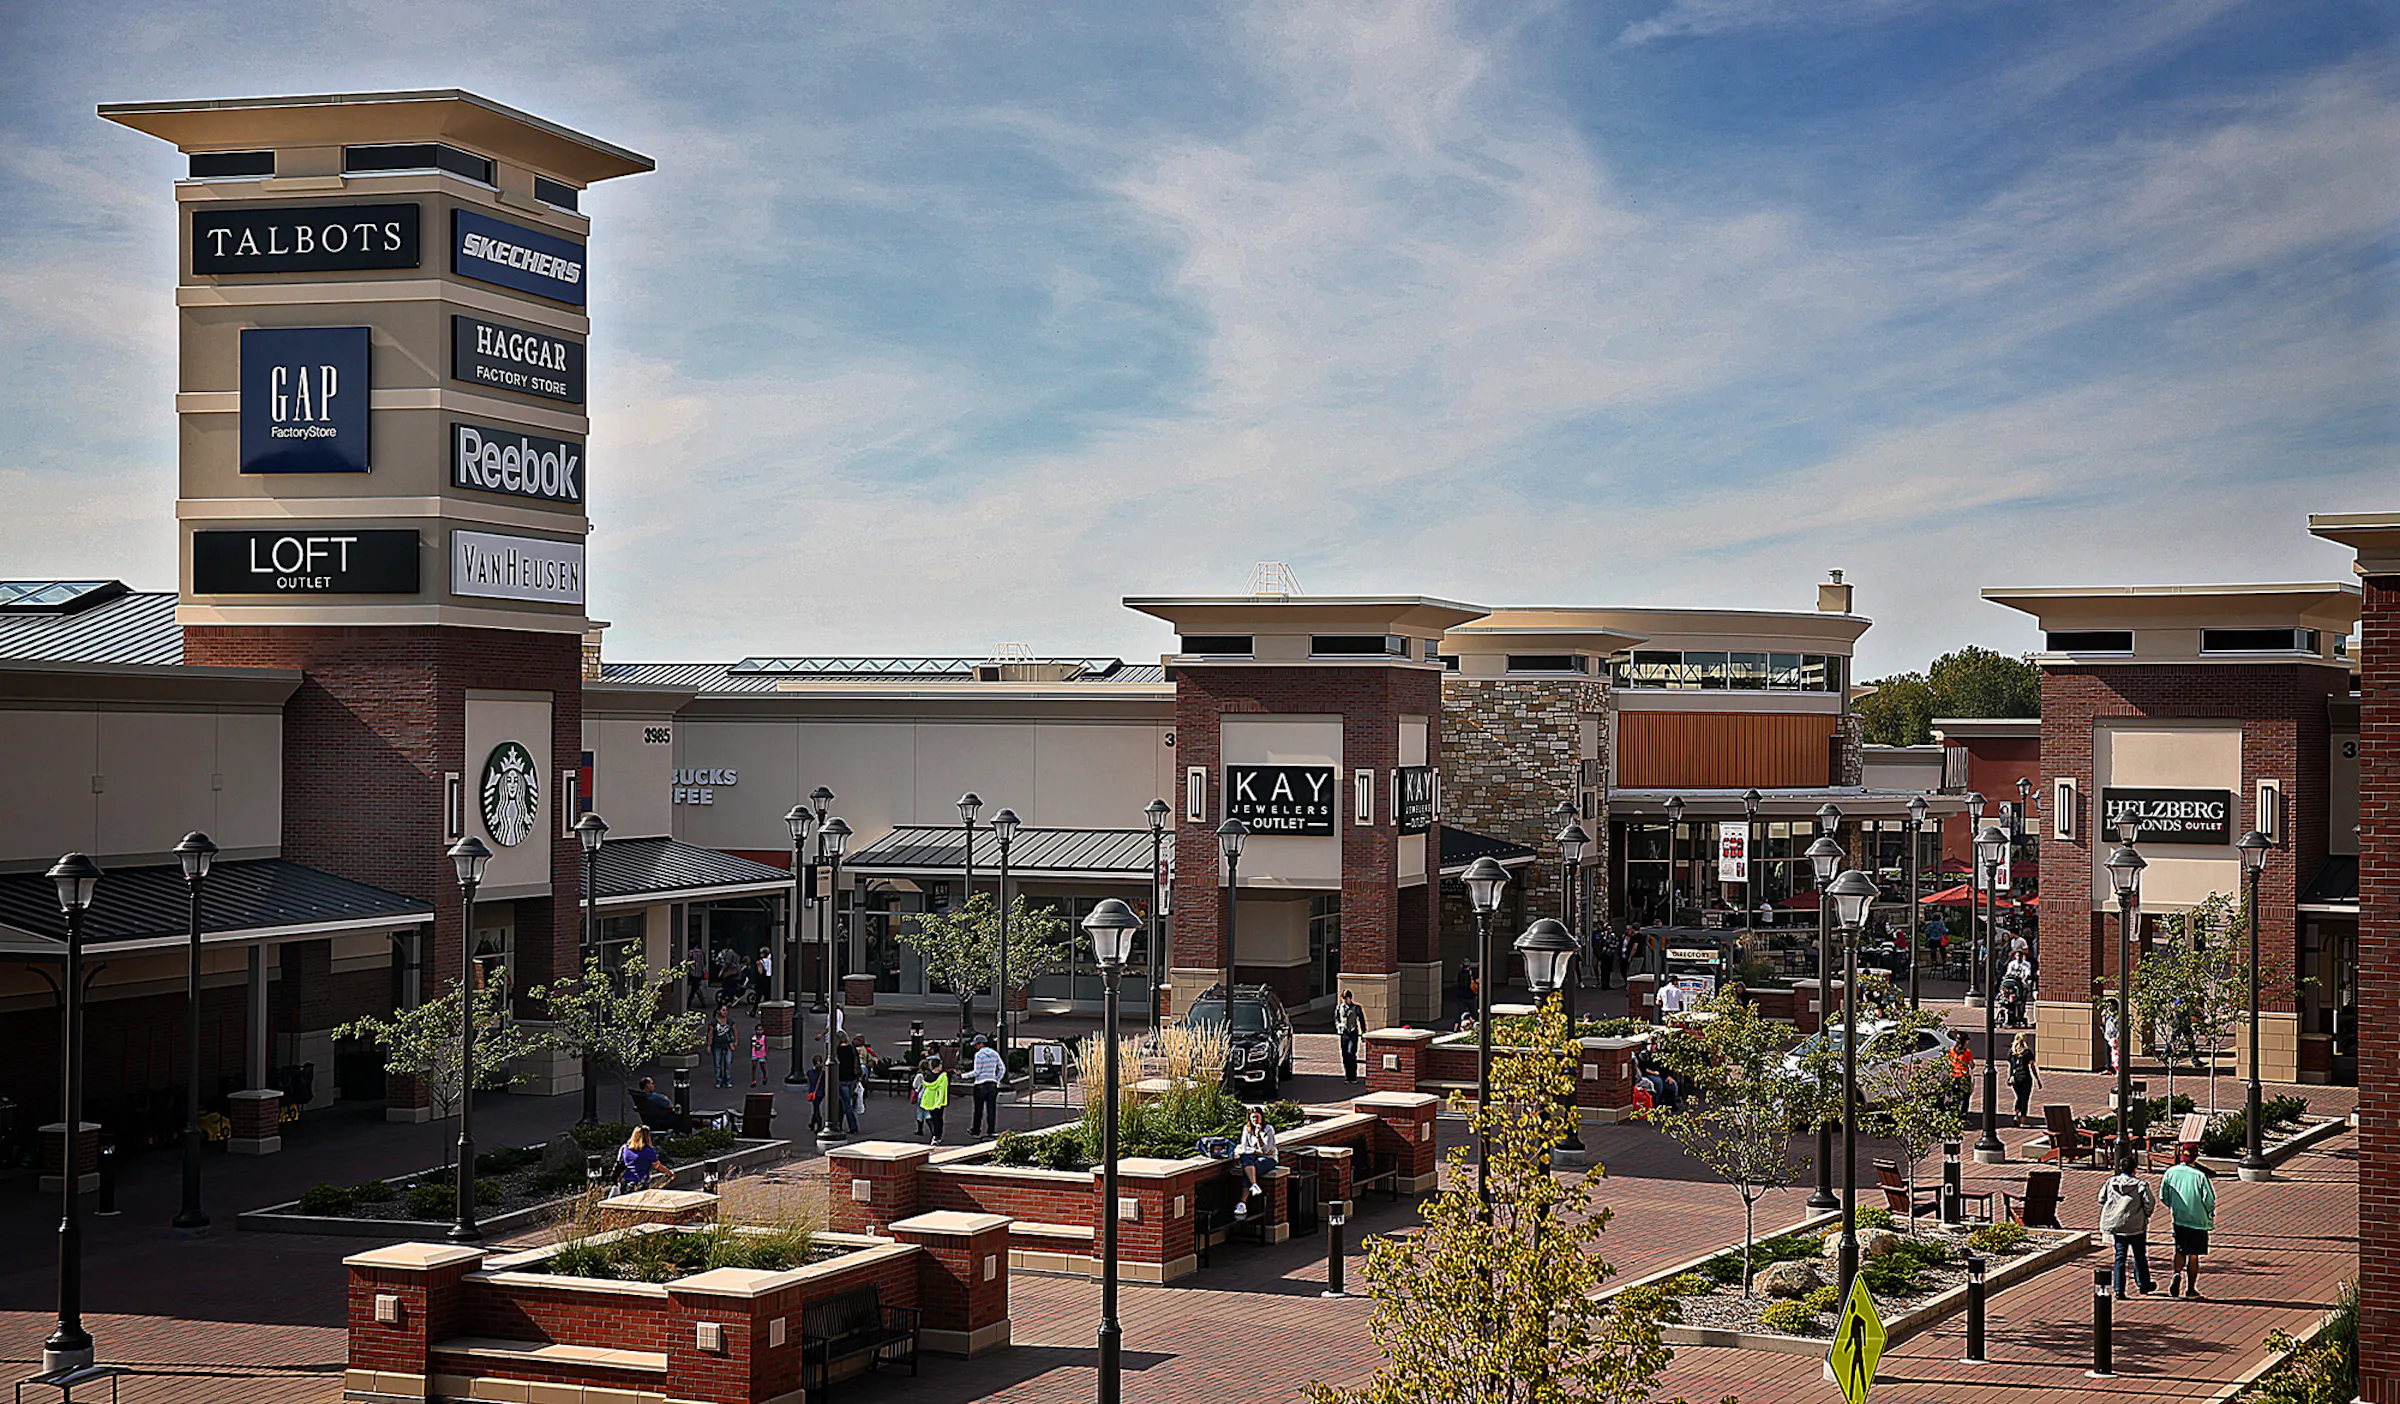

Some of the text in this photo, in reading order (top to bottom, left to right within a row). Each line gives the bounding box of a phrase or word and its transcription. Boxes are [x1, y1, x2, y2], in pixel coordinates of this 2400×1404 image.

[207, 222, 401, 257] TALBOTS
[462, 232, 582, 285] SKECHERS
[476, 325, 567, 372] HAGGAR
[271, 365, 338, 423] GAP
[476, 366, 567, 396] FACTORY STORE
[459, 427, 580, 500] Reebok
[250, 536, 358, 574] LOFT
[276, 576, 332, 589] OUTLET
[644, 727, 671, 744] 3985
[1236, 771, 1329, 802] KAY
[1406, 772, 1432, 802] KAY
[1231, 804, 1329, 815] JEWELERS
[1252, 817, 1306, 829] OUTLET
[2105, 799, 2226, 820] HELZBERG
[2184, 821, 2224, 831] OUTLET
